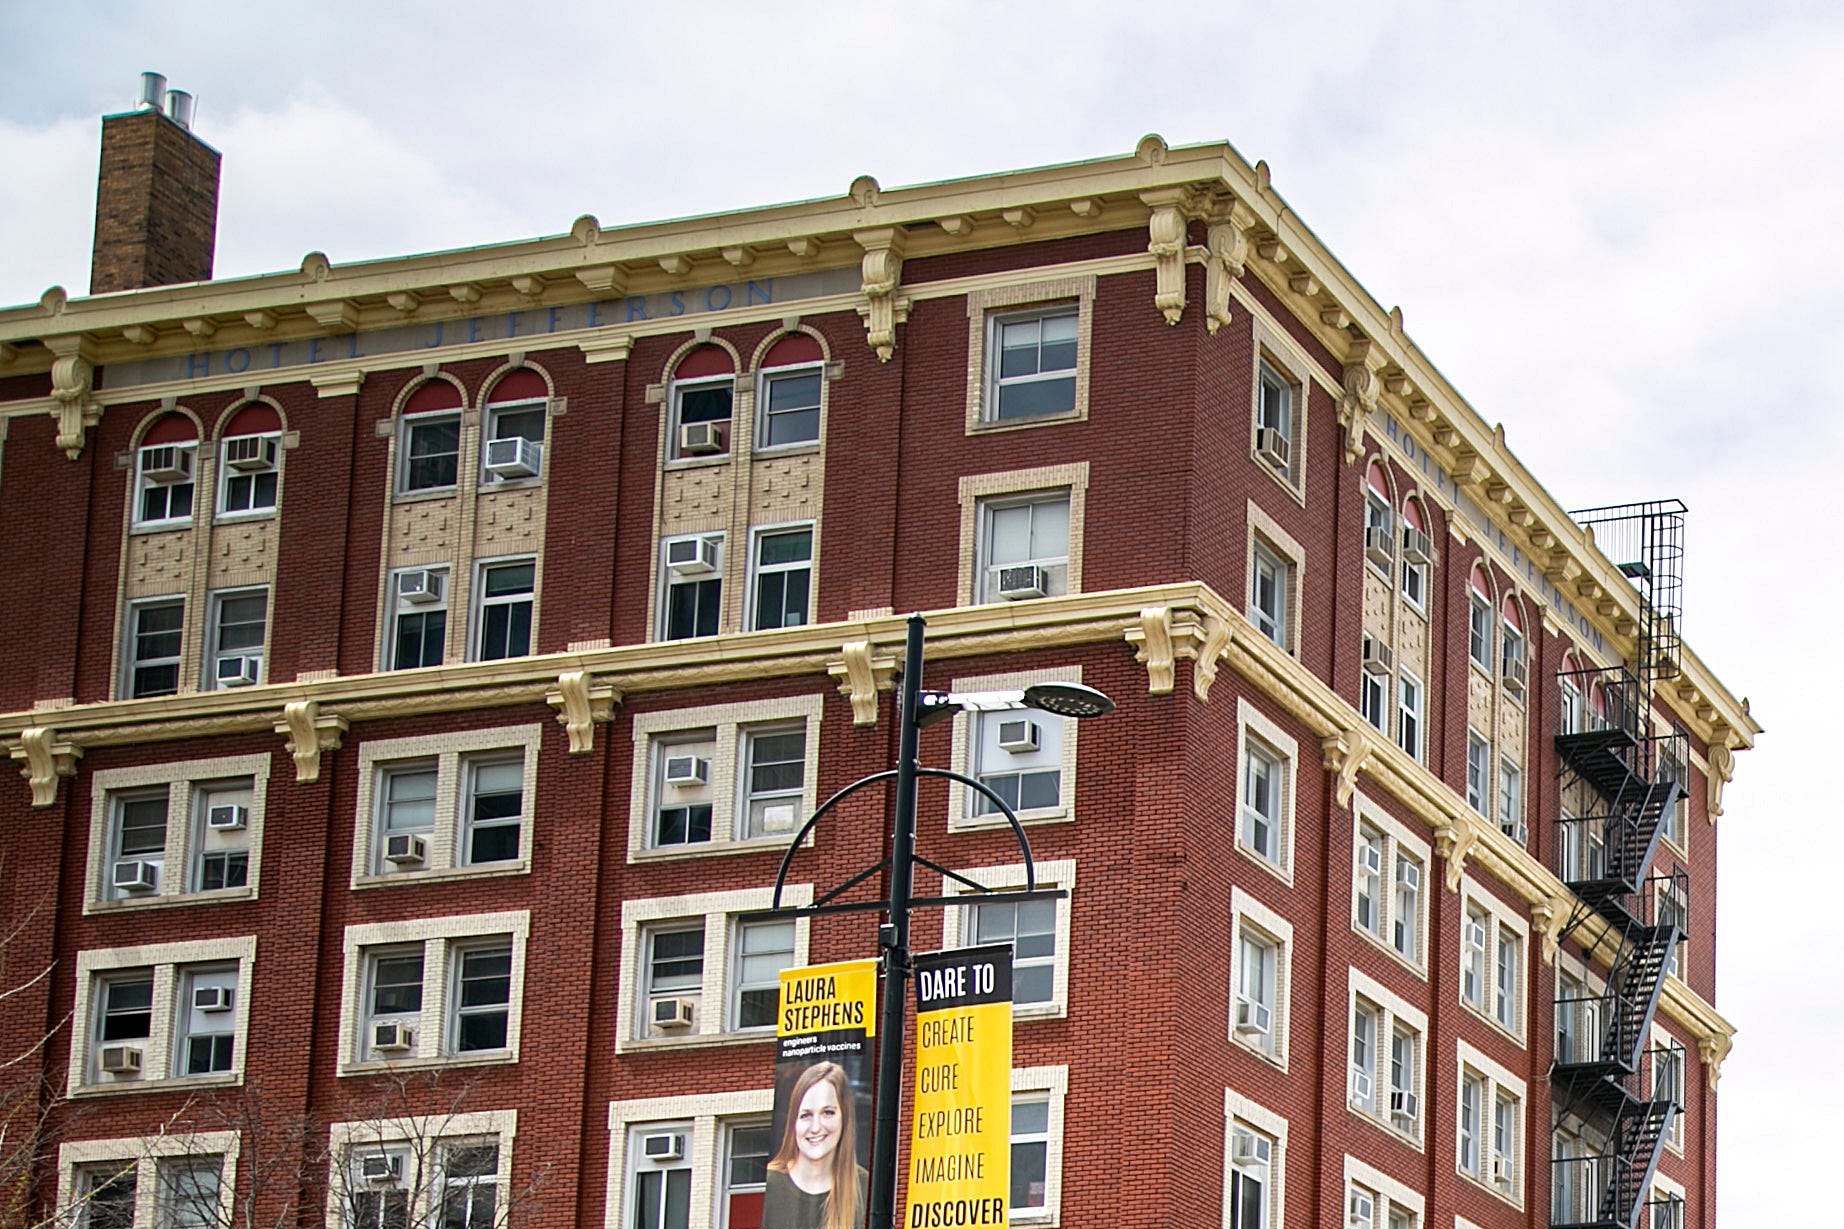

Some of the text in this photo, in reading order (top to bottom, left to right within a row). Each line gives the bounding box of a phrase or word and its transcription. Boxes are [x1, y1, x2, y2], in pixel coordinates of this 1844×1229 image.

[186, 277, 774, 379] HOTEL JEFFERSON
[785, 976, 836, 1005] LAURA
[920, 963, 995, 1002] DARE TO
[784, 1000, 864, 1032] STEPHENS
[922, 1016, 975, 1048] CREATE
[782, 1041, 861, 1057] nanoparticle vaccines
[783, 1036, 818, 1048] engineers
[921, 1063, 958, 1093] CURE
[918, 1107, 983, 1139] EXPLORE
[915, 1152, 985, 1184] IMAGINE
[911, 1198, 1003, 1229] DISCOVER
